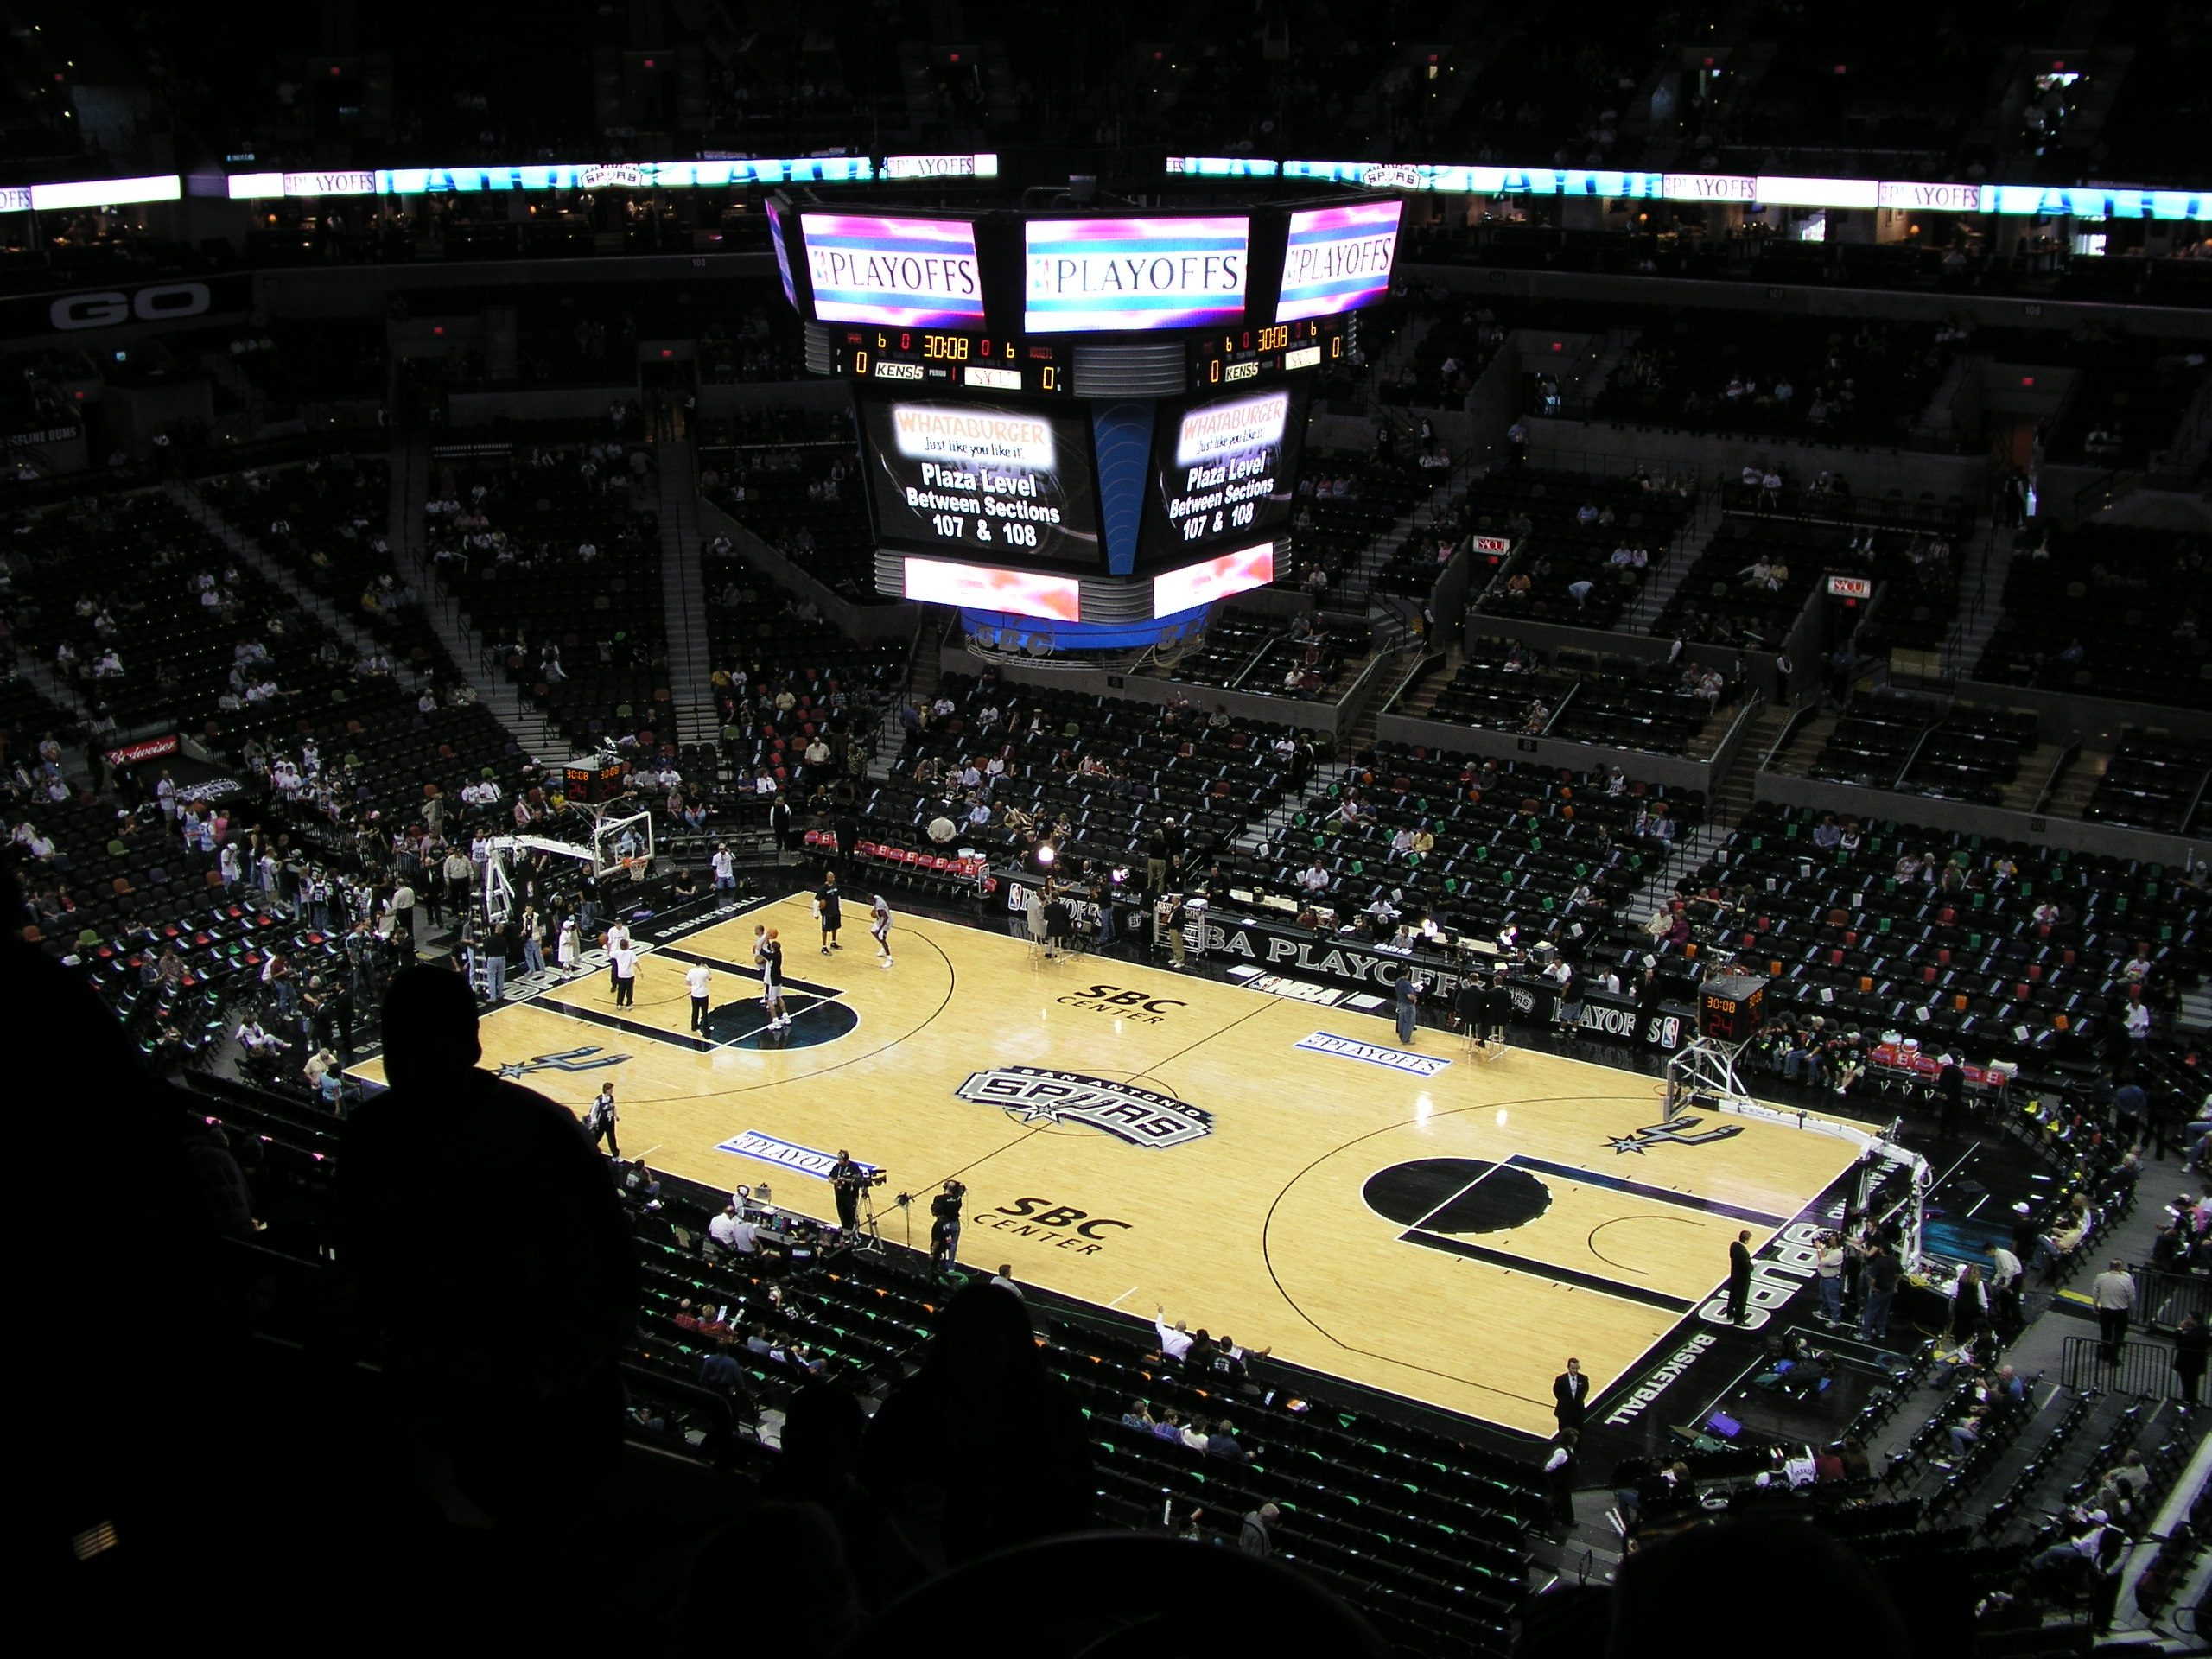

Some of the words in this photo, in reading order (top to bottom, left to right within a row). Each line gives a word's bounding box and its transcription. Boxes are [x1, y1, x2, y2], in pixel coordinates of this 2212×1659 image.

[294, 173, 374, 192] PAYOFFS
[897, 157, 973, 176] PAYOFFS
[1672, 178, 1755, 199] PAYOFFS
[1889, 184, 1979, 207] PAYOFFS
[829, 251, 975, 295] PLAYOFFS
[1057, 255, 1238, 294] PLAYOFFS
[1299, 237, 1392, 283] PLAYOFFS
[49, 283, 211, 331] GO
[900, 333, 911, 350] 0
[923, 334, 969, 360] 30:08
[981, 339, 990, 357] 0
[1258, 325, 1288, 352] 30:08
[855, 351, 868, 374] 0
[1042, 365, 1054, 390] 0
[1210, 359, 1220, 383] 0
[895, 410, 1046, 445] WHATABURGER
[1184, 399, 1283, 441] WHATABURGER
[925, 436, 946, 451] Just
[948, 438, 968, 454] like
[969, 445, 988, 458] you
[991, 443, 1011, 457] like
[920, 462, 977, 492] Plaza
[981, 469, 1038, 498] Level
[1186, 466, 1226, 492] Plaza
[1228, 449, 1268, 481] Level
[906, 486, 981, 515] Between
[983, 495, 1061, 524] Sections
[1169, 491, 1223, 519] Between
[1224, 477, 1274, 505] Sections
[932, 513, 964, 538] 107
[976, 518, 993, 542] &
[1002, 522, 1037, 547] 108
[1183, 515, 1208, 541] 107
[1212, 510, 1224, 533] &
[1231, 502, 1255, 527] 108
[569, 782, 588, 801] 24
[654, 895, 767, 938] BASKETBALL
[1189, 924, 1255, 958] BA
[1056, 995, 1165, 1025] CENTER
[1073, 984, 1189, 1014] SBC
[1707, 996, 1737, 1014] 30:08
[1708, 1013, 1734, 1039] 24
[1320, 1038, 1442, 1072] PLAYOFFS
[980, 1078, 1192, 1139] SPURS
[1020, 1068, 1077, 1082] SAN
[1088, 1079, 1203, 1118] ANTONIO
[743, 1138, 838, 1171] PLAYOF
[973, 1213, 1103, 1255] CENTER
[994, 1197, 1134, 1241] SBC
[1698, 1222, 1834, 1331] SPURS
[1604, 1332, 1718, 1425] BASKETBALL
